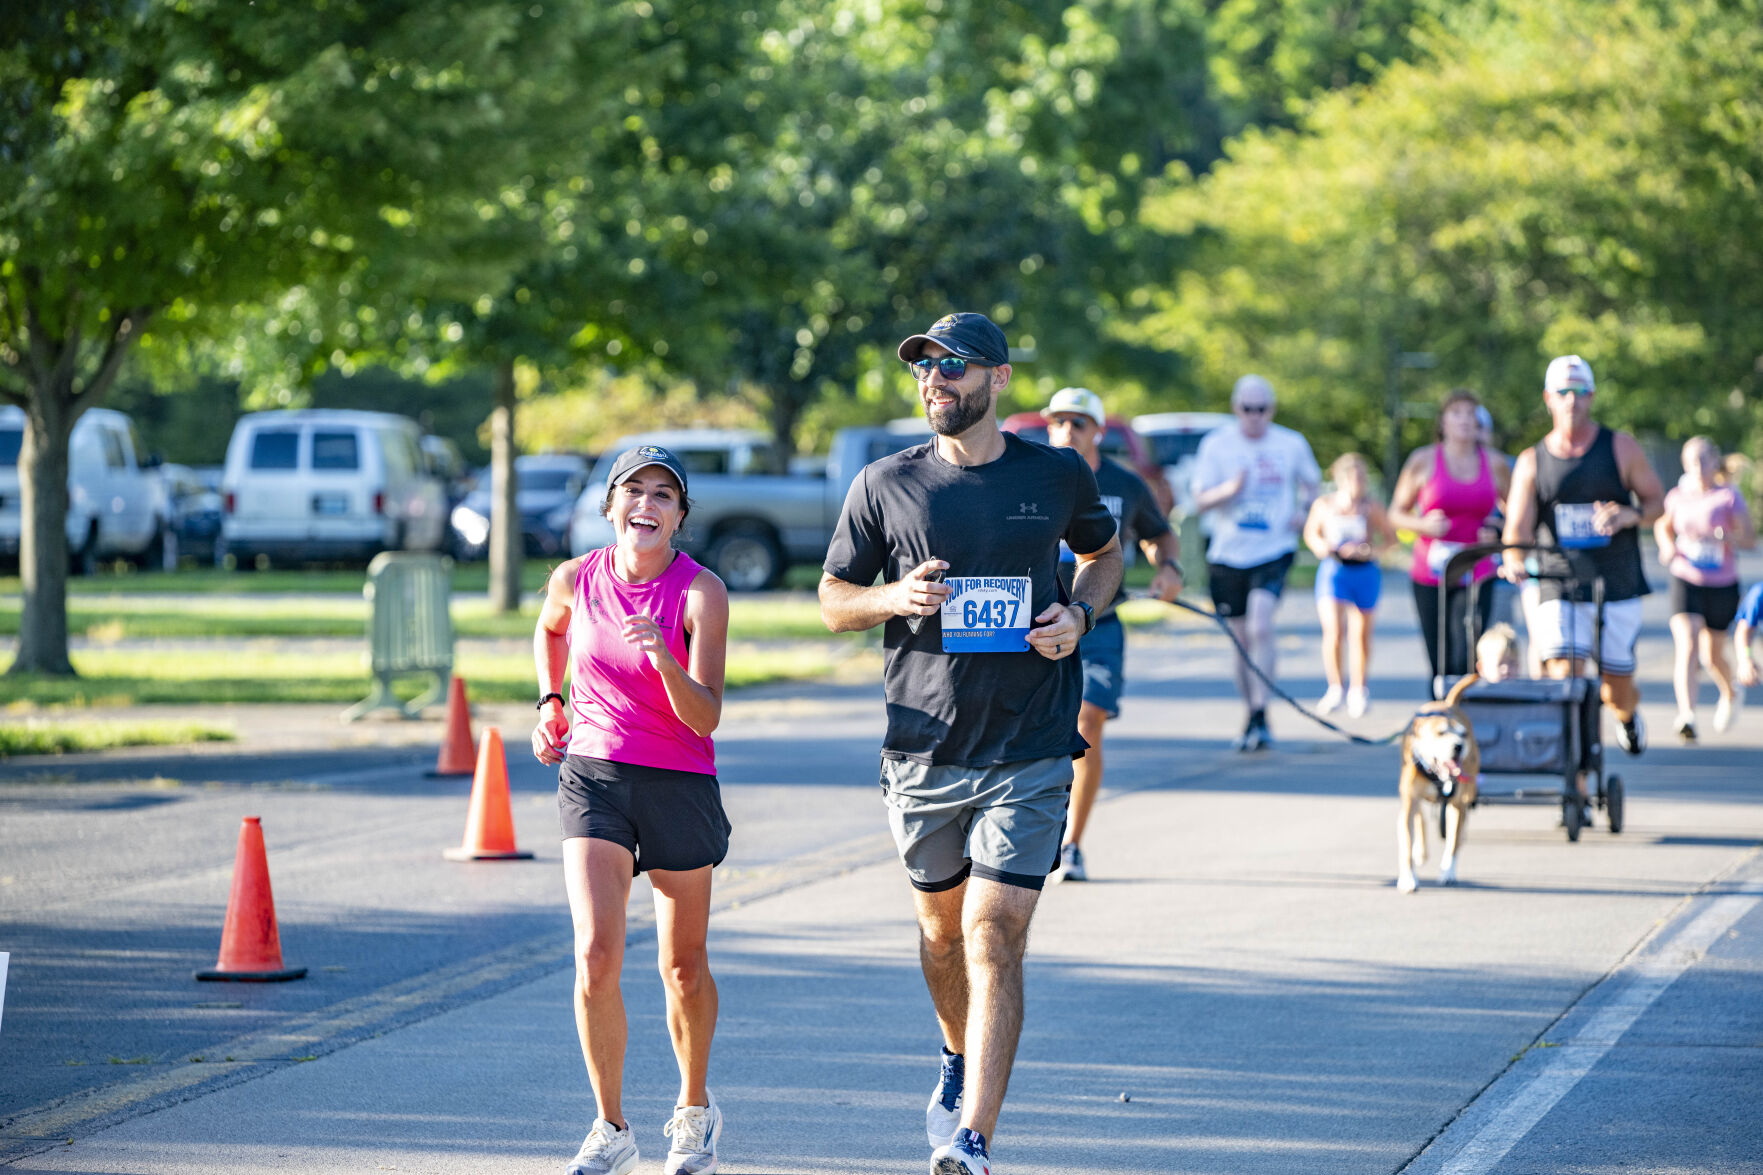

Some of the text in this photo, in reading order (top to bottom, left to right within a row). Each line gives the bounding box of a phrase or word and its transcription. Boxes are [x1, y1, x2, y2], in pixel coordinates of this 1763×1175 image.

[965, 579, 982, 592] FOR
[984, 579, 1027, 604] RECOVERY
[963, 600, 1020, 628] 6437
